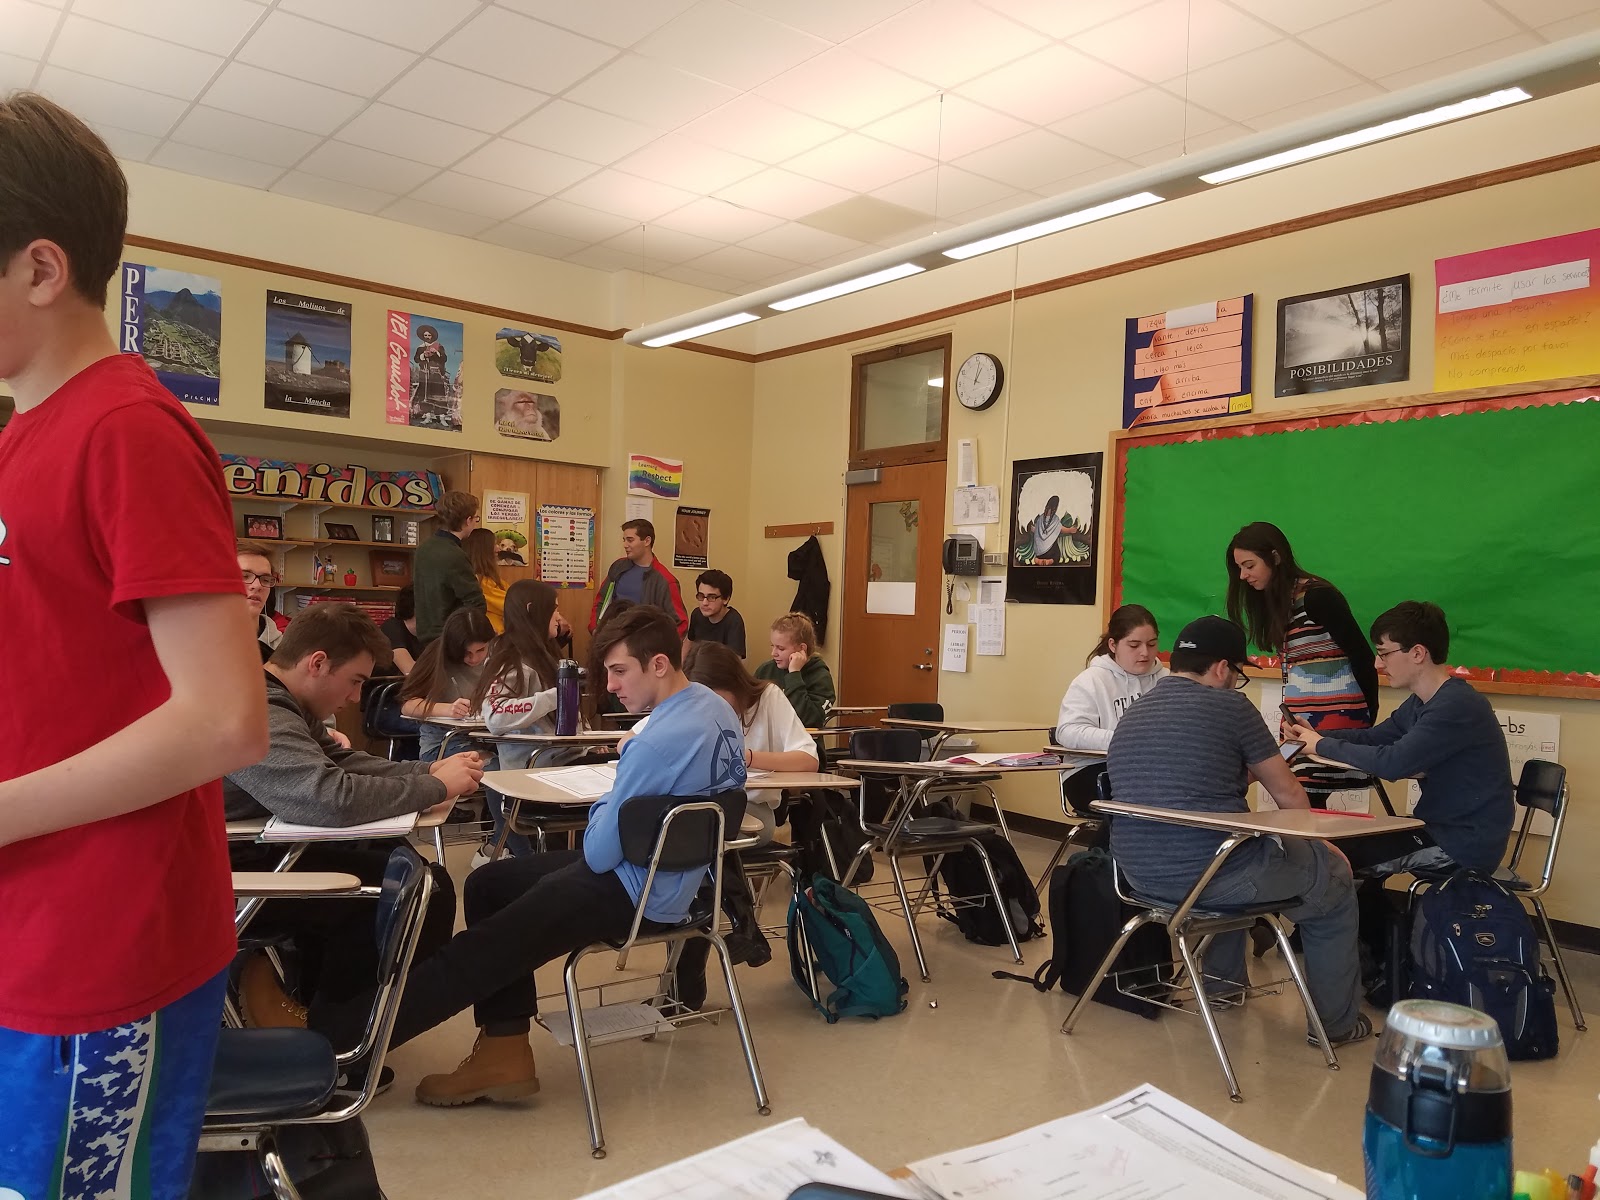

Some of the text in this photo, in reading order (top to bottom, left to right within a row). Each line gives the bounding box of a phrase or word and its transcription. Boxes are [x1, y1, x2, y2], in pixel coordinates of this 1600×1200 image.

[273, 296, 287, 305] Los
[298, 300, 327, 312] Molinos
[1290, 355, 1393, 380] POSIBILIDADES
[305, 396, 332, 408] Mancha
[642, 469, 673, 482] Respect
